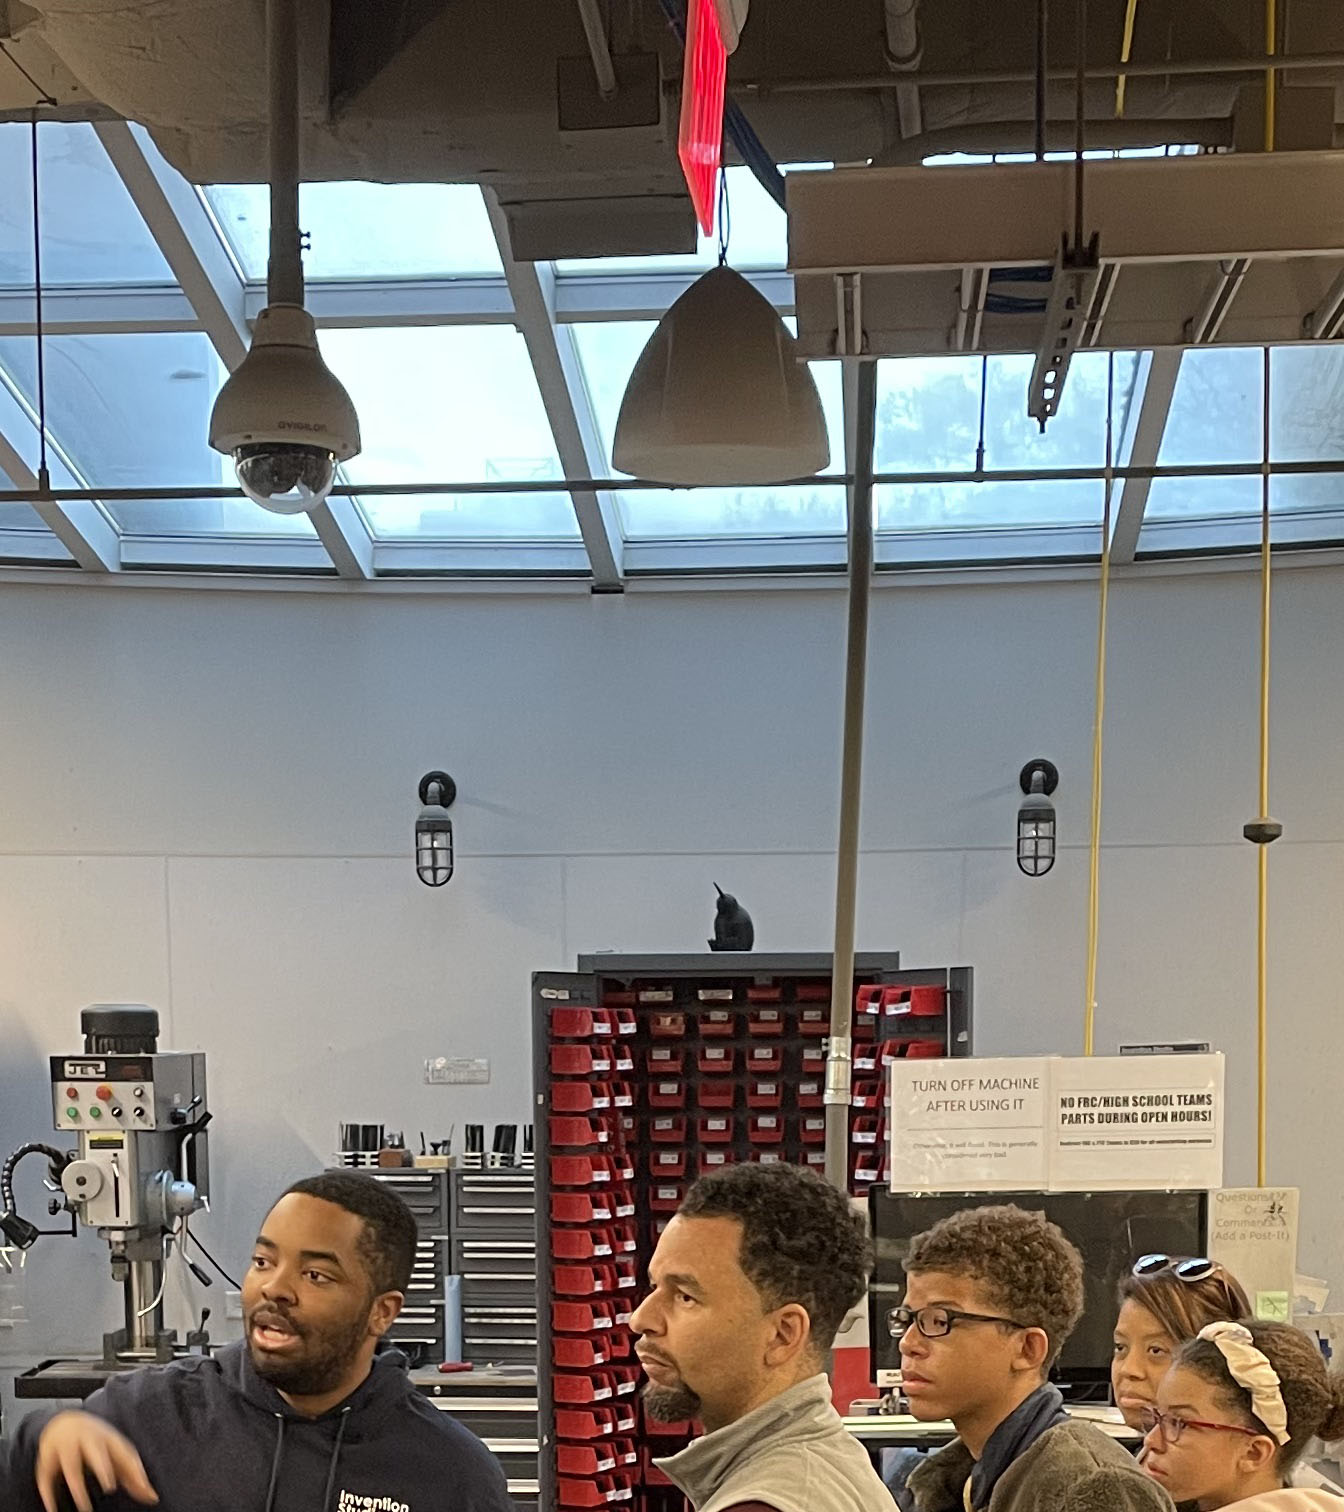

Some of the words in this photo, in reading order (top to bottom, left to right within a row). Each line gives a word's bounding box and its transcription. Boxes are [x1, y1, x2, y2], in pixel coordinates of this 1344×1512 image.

[911, 1080, 947, 1092] TURN
[950, 1079, 975, 1091] OFF
[978, 1077, 1040, 1090] MACHINE
[926, 1100, 966, 1112] AFTER
[969, 1099, 1010, 1111] USING
[1013, 1098, 1025, 1110] IT
[1060, 1096, 1075, 1108] NO
[1077, 1095, 1129, 1108] FRC/HIGH
[1131, 1094, 1174, 1107] SCHOOL
[1176, 1093, 1213, 1106] TEAMS
[1061, 1112, 1095, 1124] PARTS
[1097, 1111, 1139, 1124] DURING
[1140, 1110, 1168, 1123] OPEN
[1170, 1109, 1212, 1122] HOURS!
